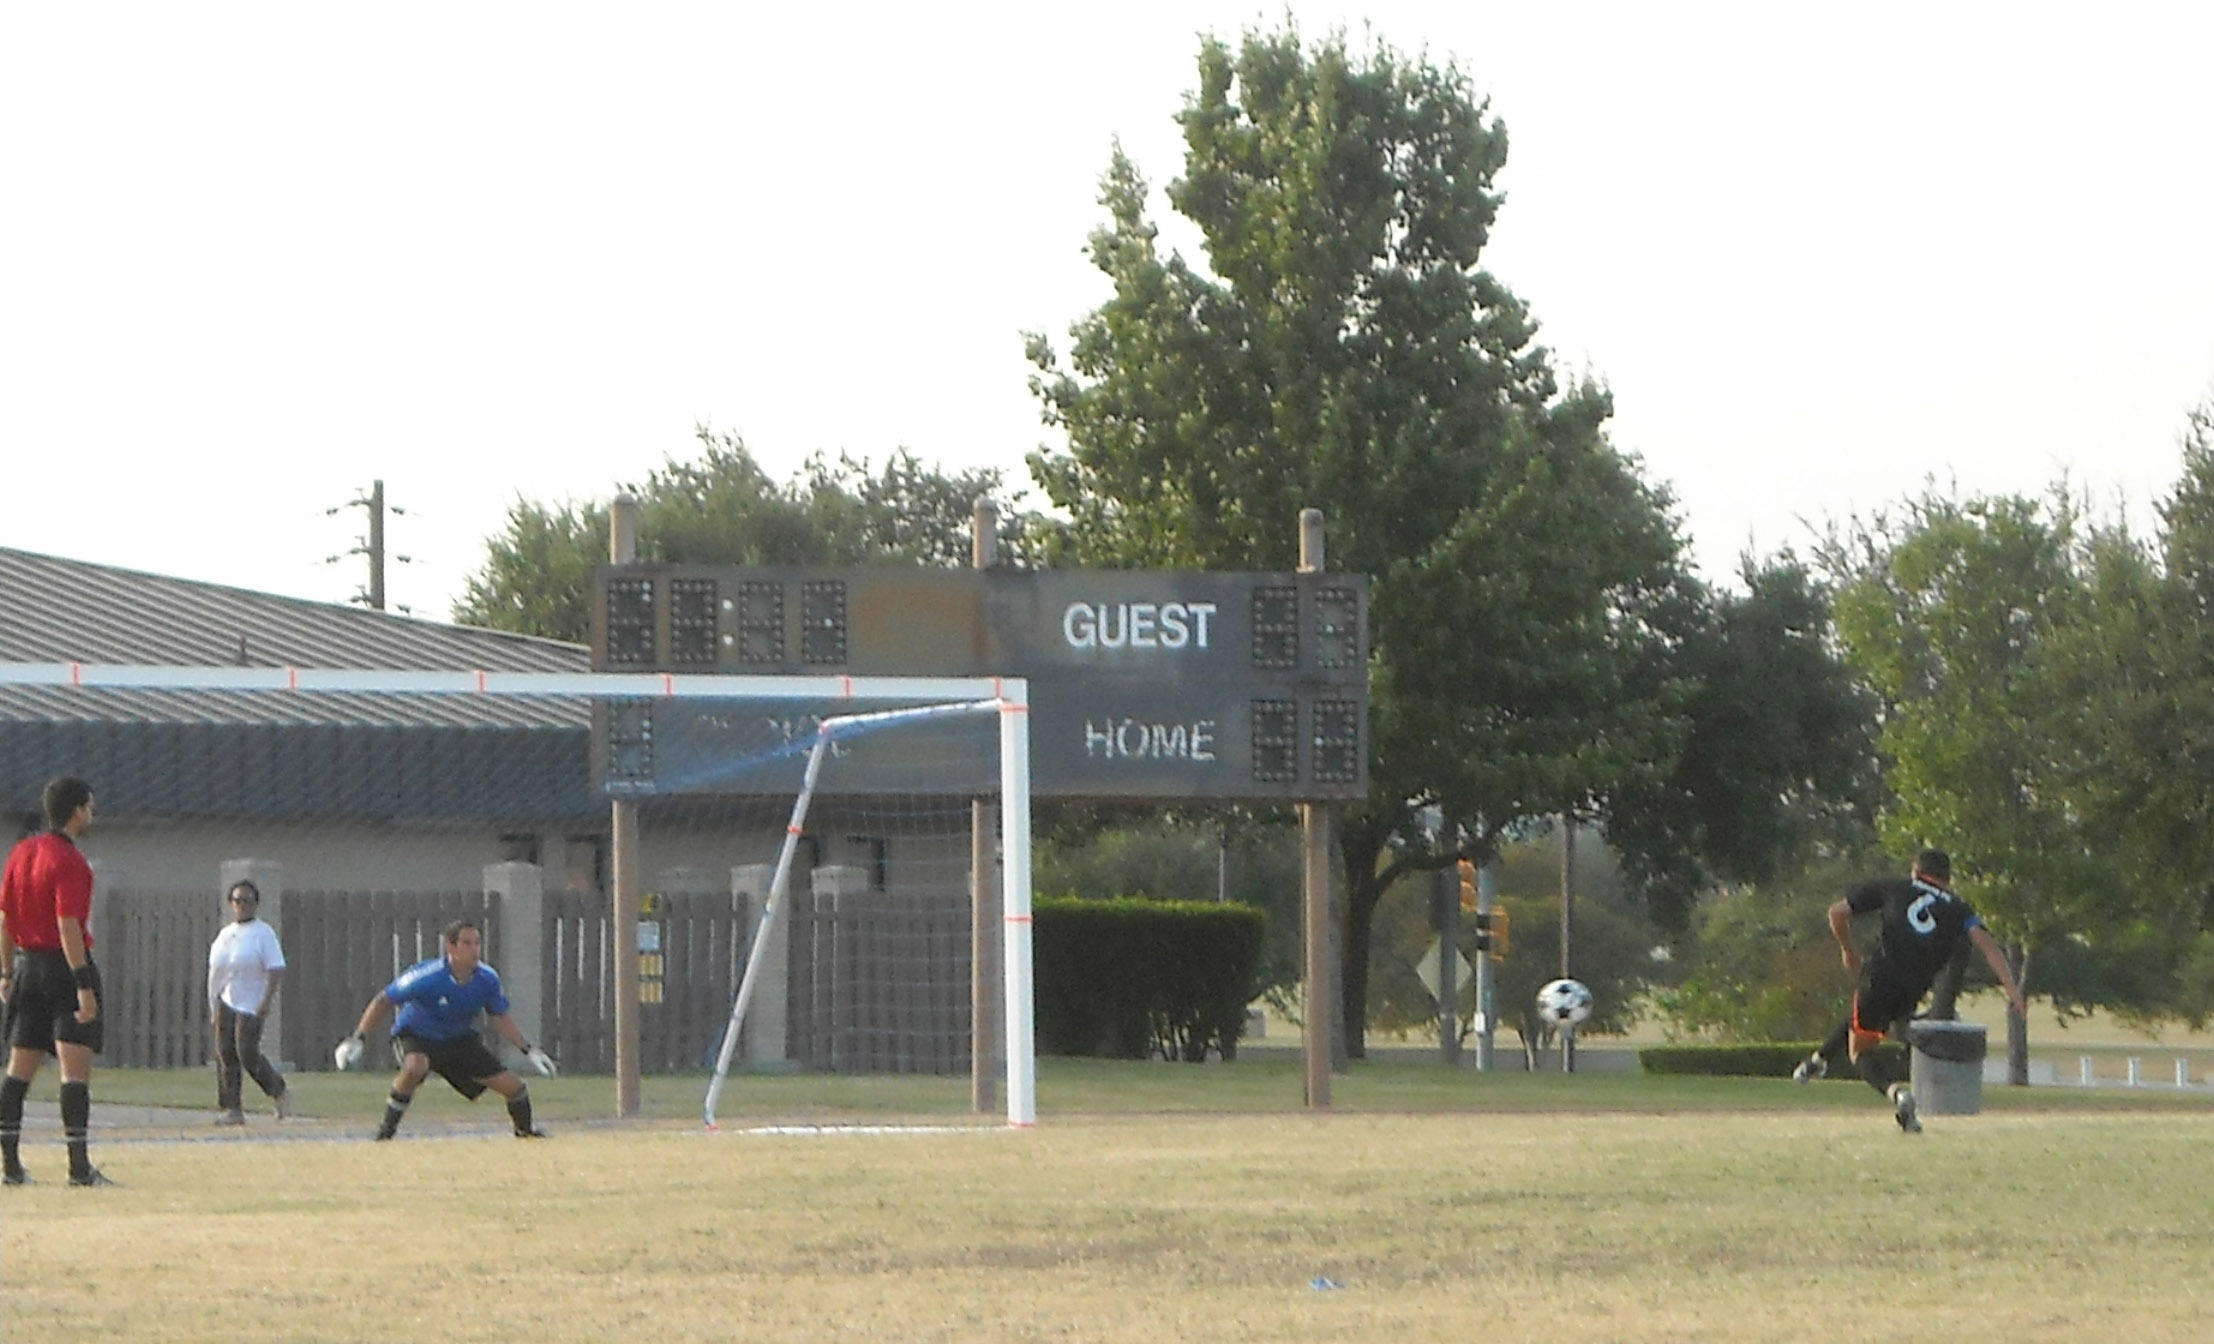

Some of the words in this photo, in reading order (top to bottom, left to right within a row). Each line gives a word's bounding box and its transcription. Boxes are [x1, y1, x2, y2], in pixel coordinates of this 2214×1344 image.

[1063, 601, 1217, 648] GUEST
[1085, 717, 1216, 761] HOME
[1907, 893, 1938, 934] 6
